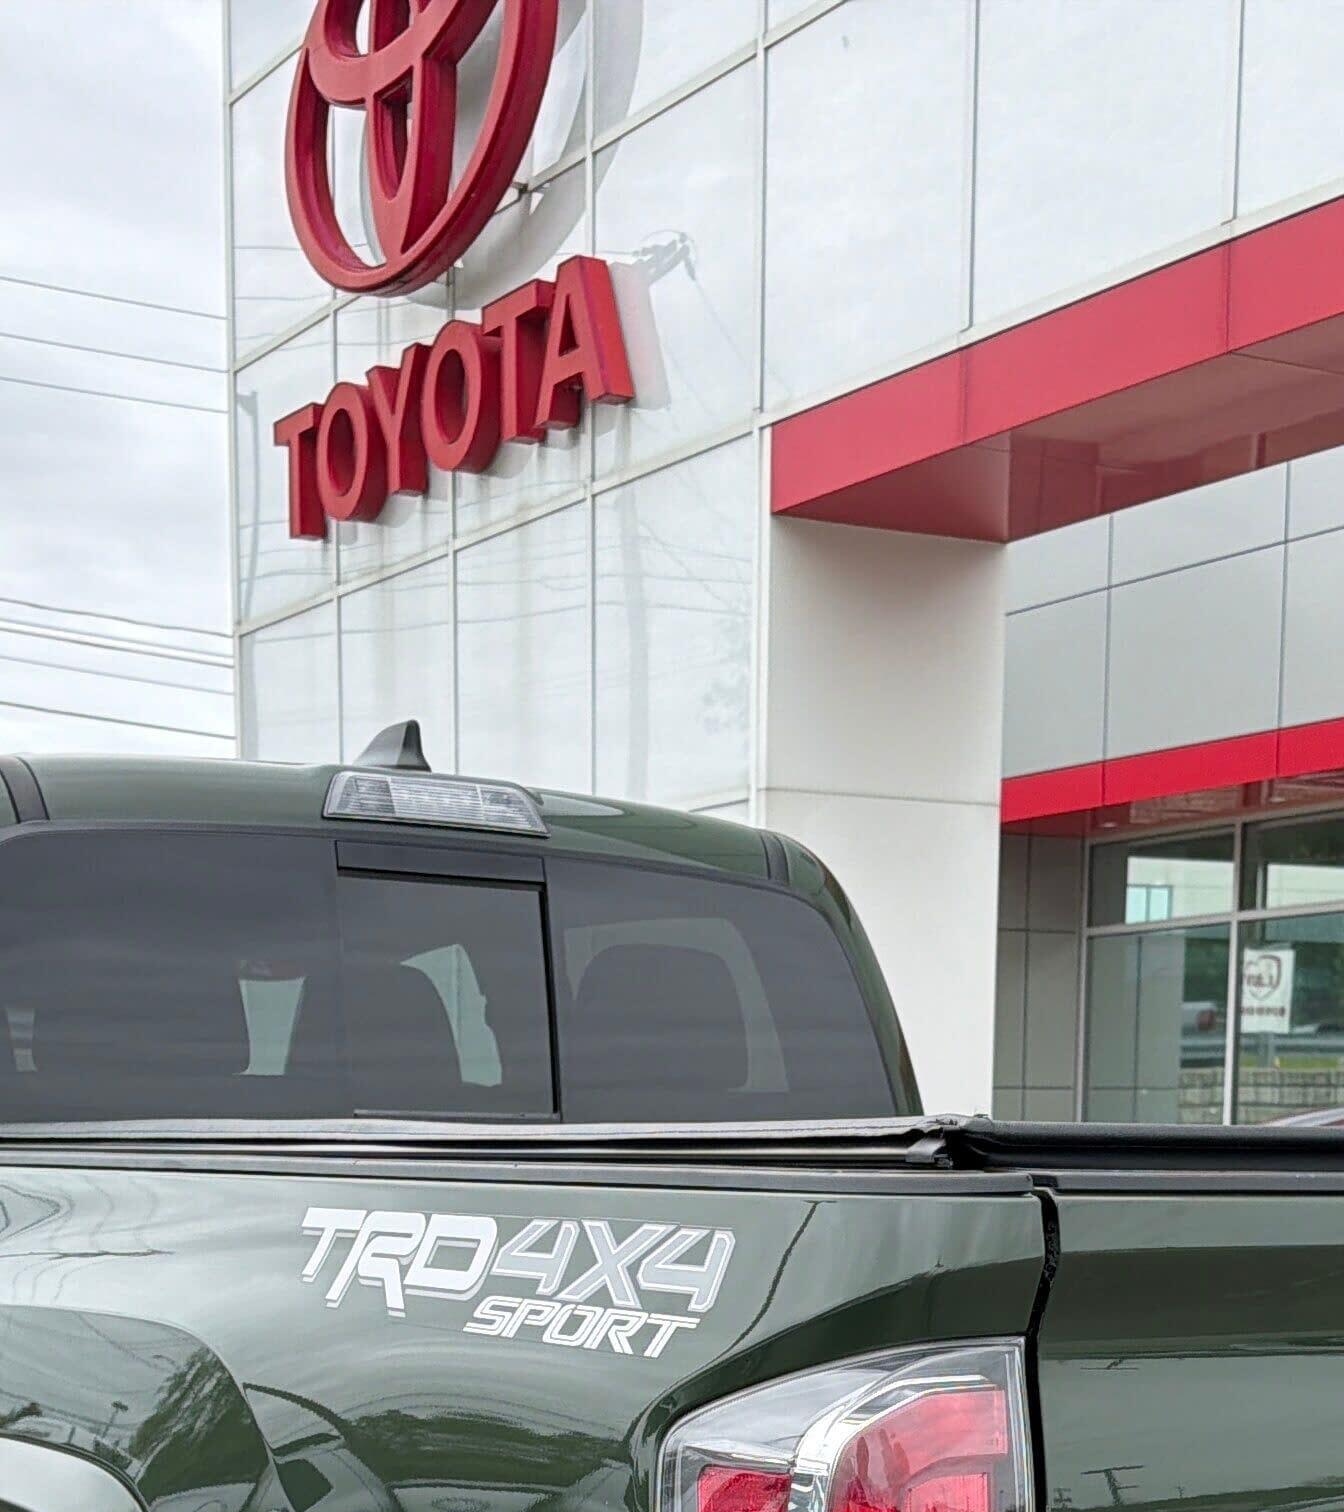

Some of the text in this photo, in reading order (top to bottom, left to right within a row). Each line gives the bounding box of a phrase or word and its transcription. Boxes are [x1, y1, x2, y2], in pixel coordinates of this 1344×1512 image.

[274, 254, 634, 541] TOYOTA
[301, 1206, 499, 1318] TRD
[462, 1294, 701, 1359] SPORT
